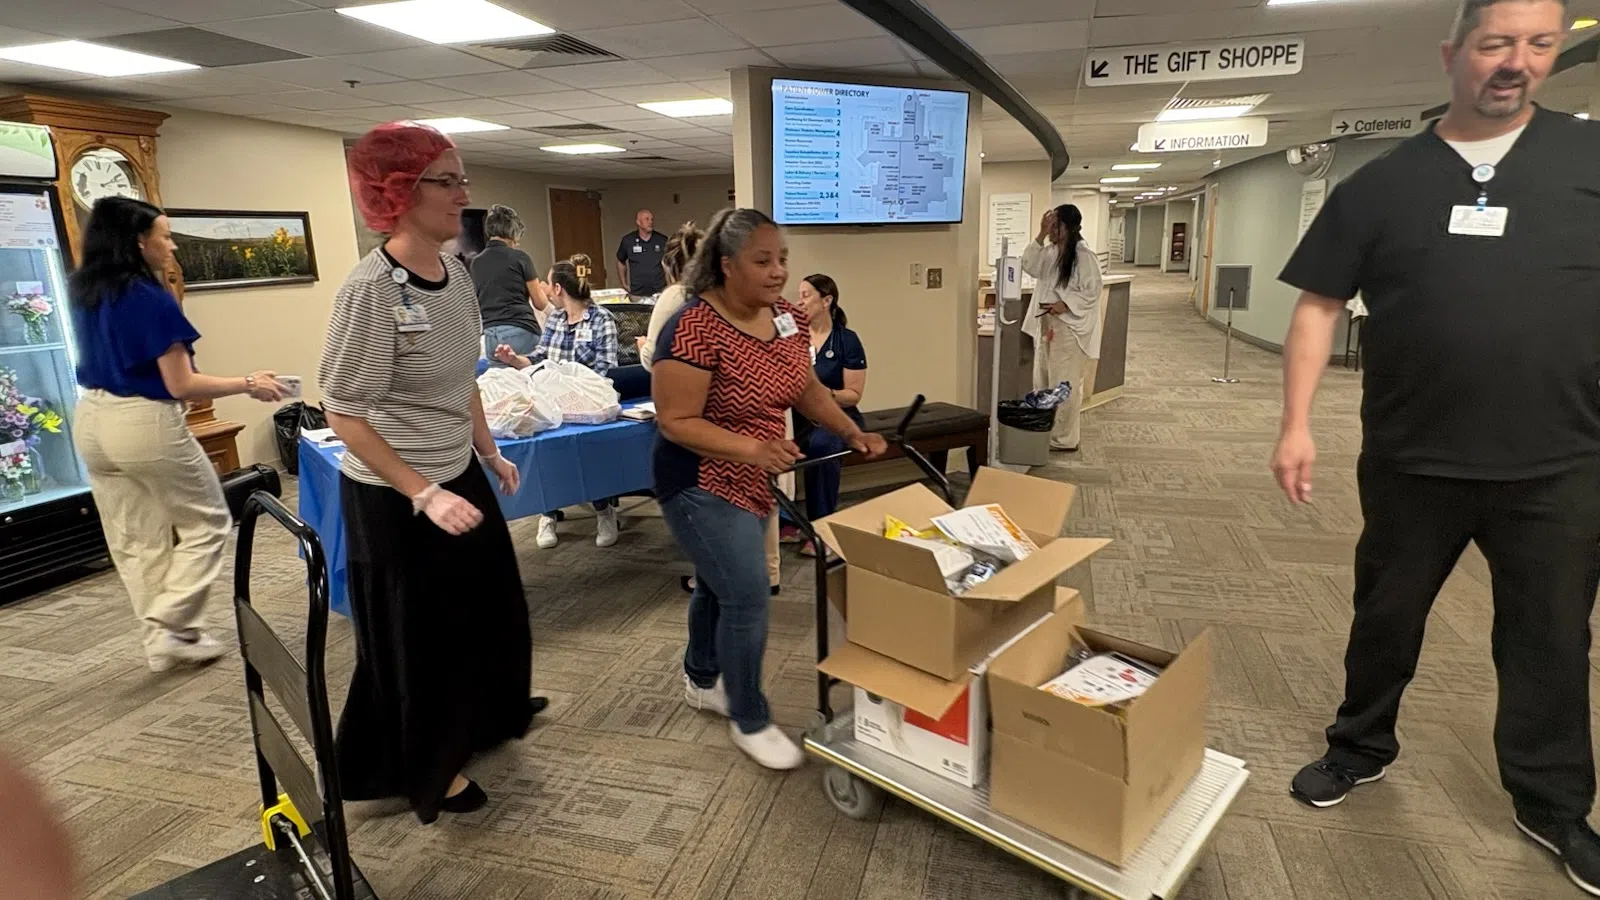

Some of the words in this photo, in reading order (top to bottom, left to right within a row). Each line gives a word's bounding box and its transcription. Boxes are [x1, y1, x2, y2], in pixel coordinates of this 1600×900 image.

[1123, 54, 1159, 75] THE
[1167, 50, 1211, 73] GIFT
[1218, 44, 1299, 70] SHOPPE
[810, 86, 834, 95] TOWER
[834, 88, 870, 98] DIRECTORY
[1354, 117, 1412, 132] Cafeteria
[1170, 134, 1250, 149] INFORMATION
